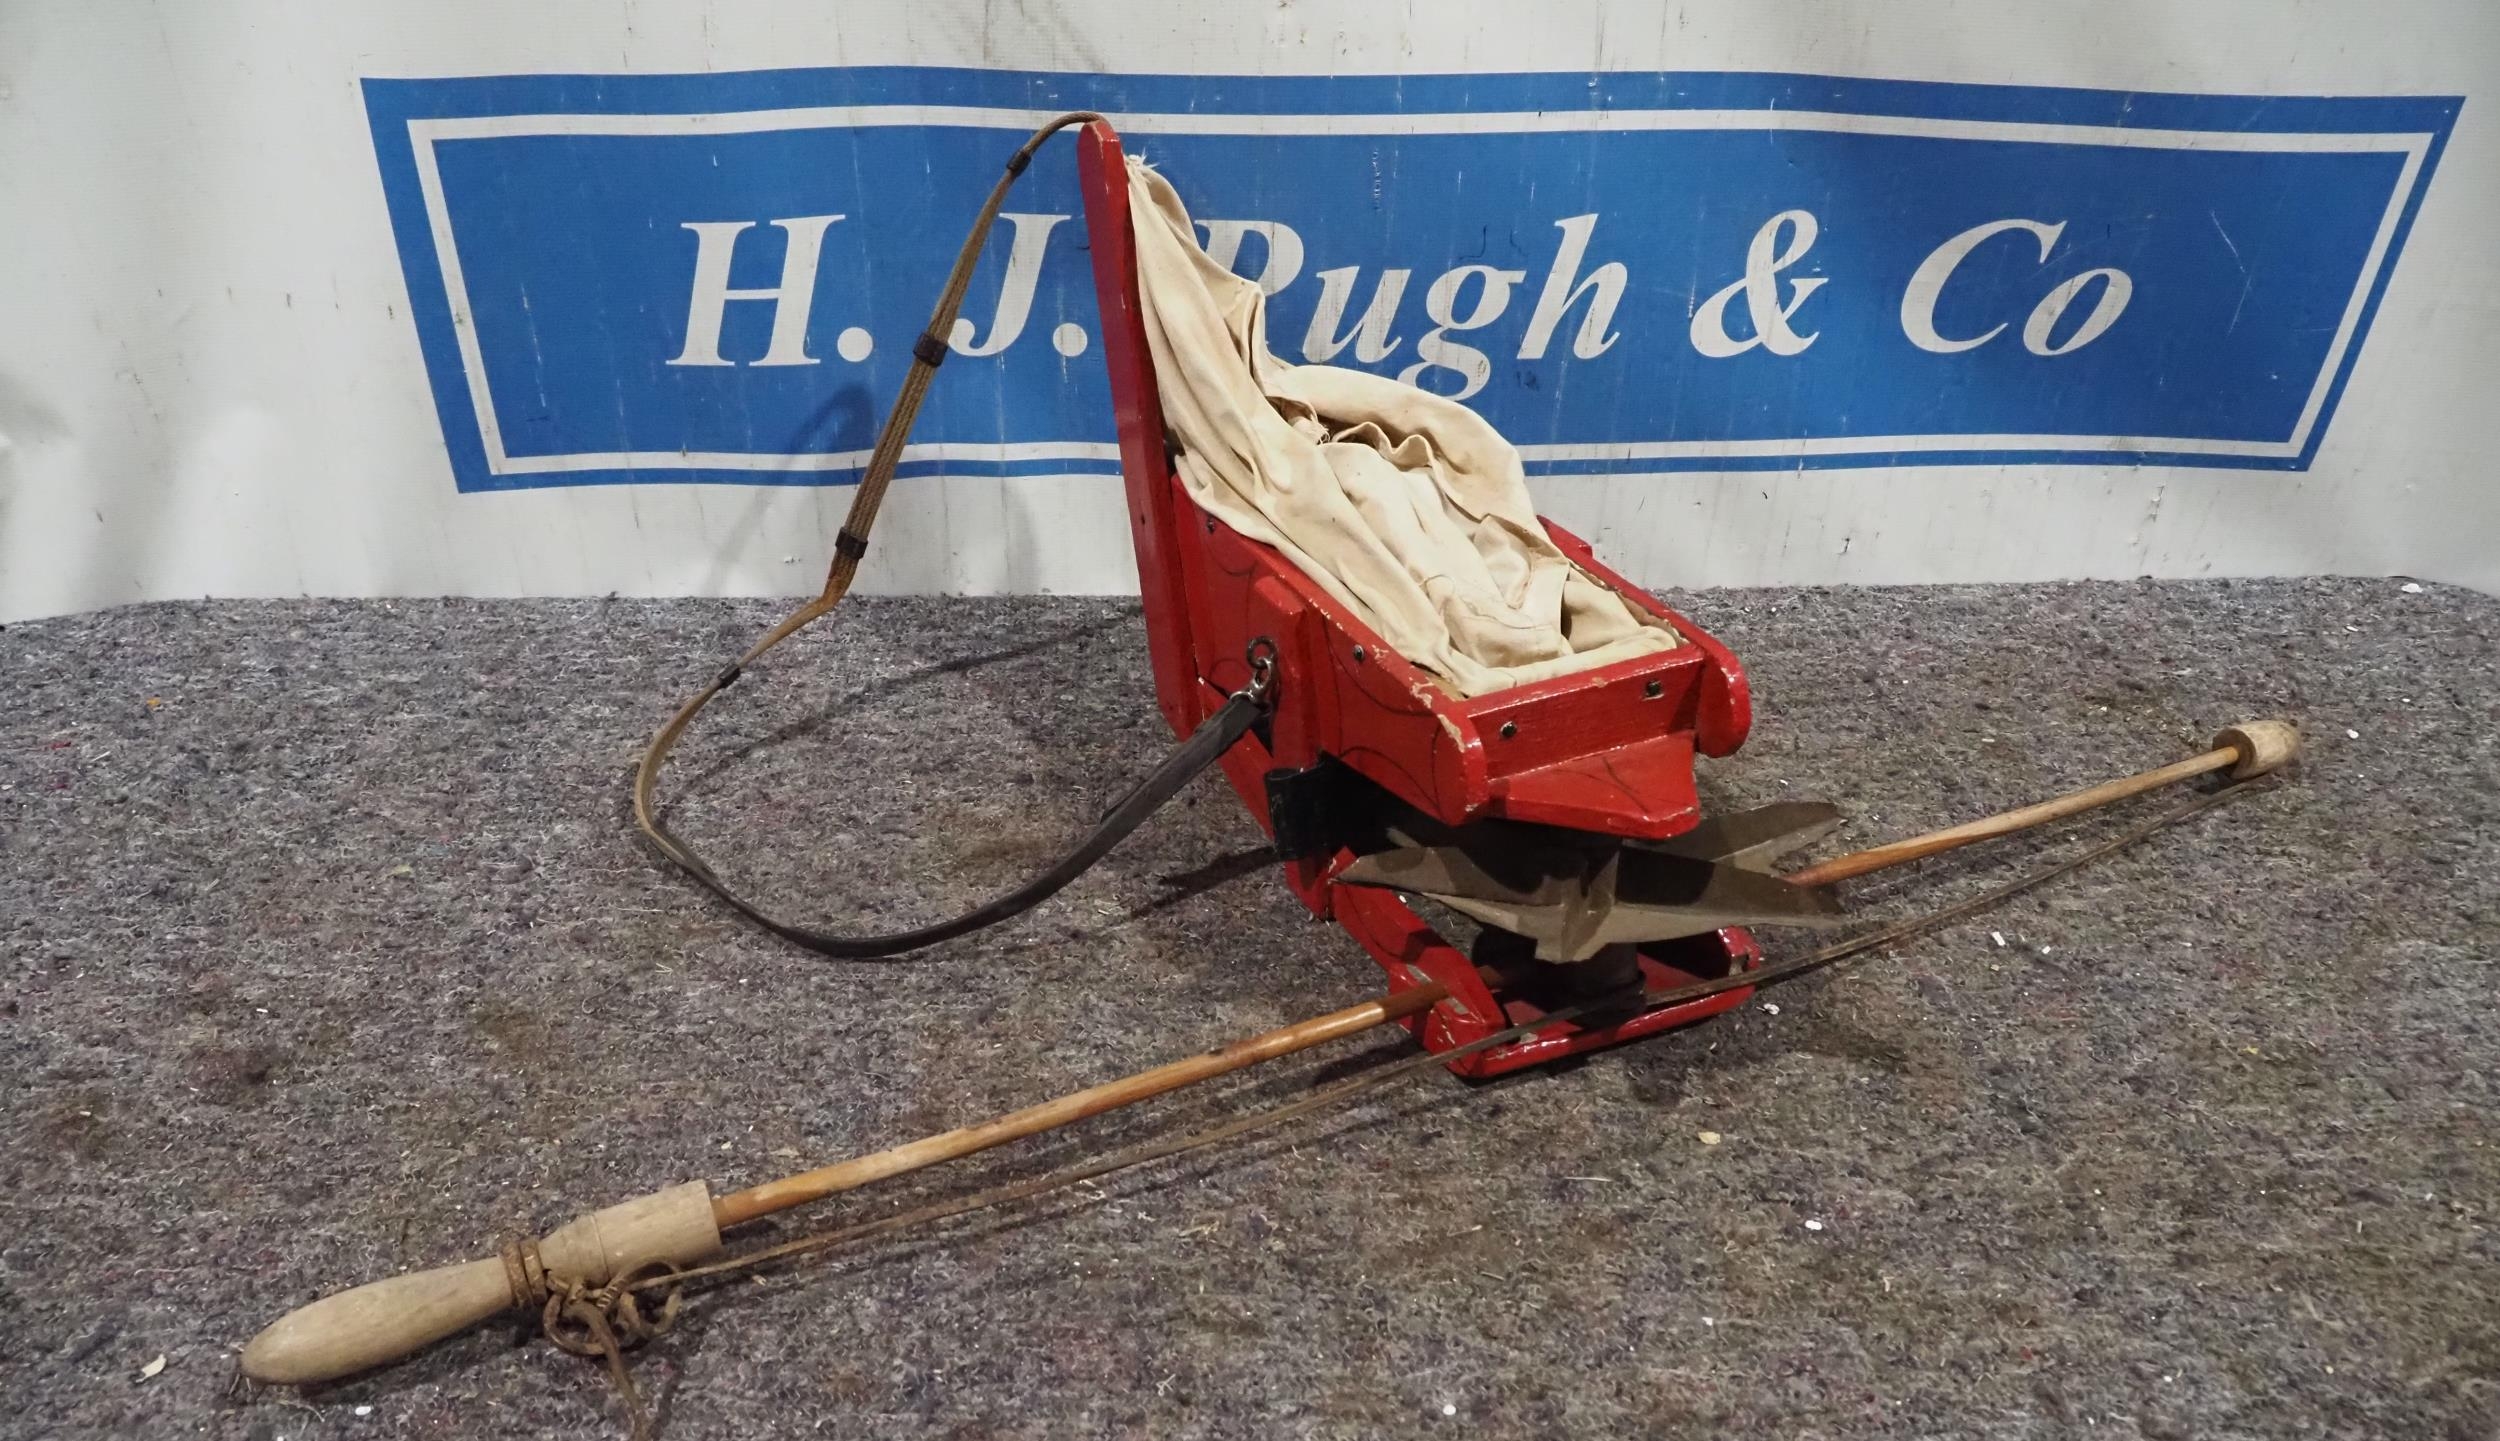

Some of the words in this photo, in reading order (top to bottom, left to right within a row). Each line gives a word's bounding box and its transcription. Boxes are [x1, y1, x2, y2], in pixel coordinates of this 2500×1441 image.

[665, 213, 875, 368] H.
[944, 211, 1088, 358] J.
[1687, 208, 1829, 359] &
[1899, 218, 2134, 357] Co
